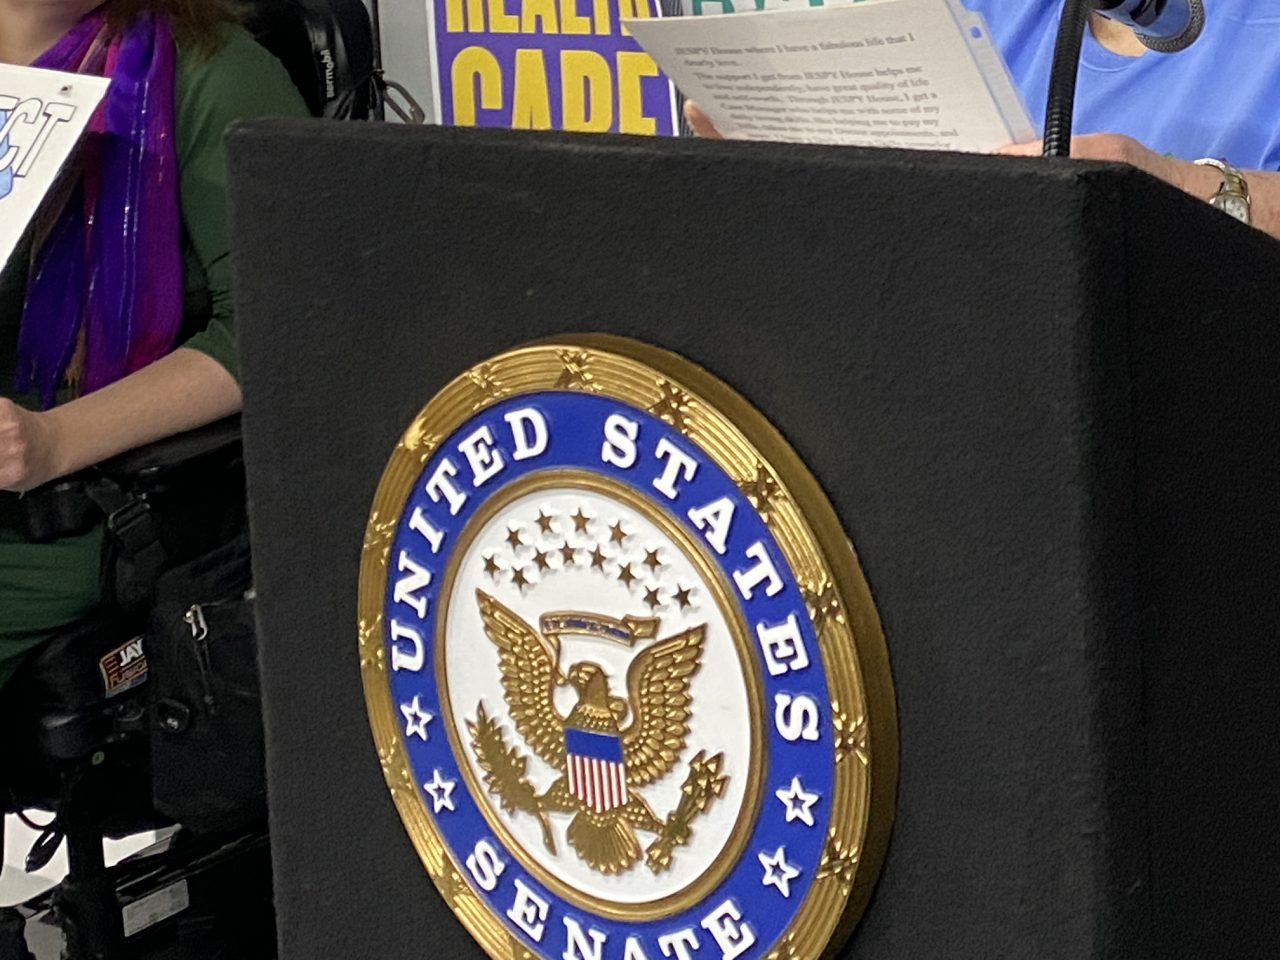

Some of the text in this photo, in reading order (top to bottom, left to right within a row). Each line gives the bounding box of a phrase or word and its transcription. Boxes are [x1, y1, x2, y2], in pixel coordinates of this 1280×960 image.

[865, 37, 885, 48] life
[885, 34, 908, 45] that
[390, 406, 820, 743] UNITED STATES
[120, 639, 143, 667] JAY
